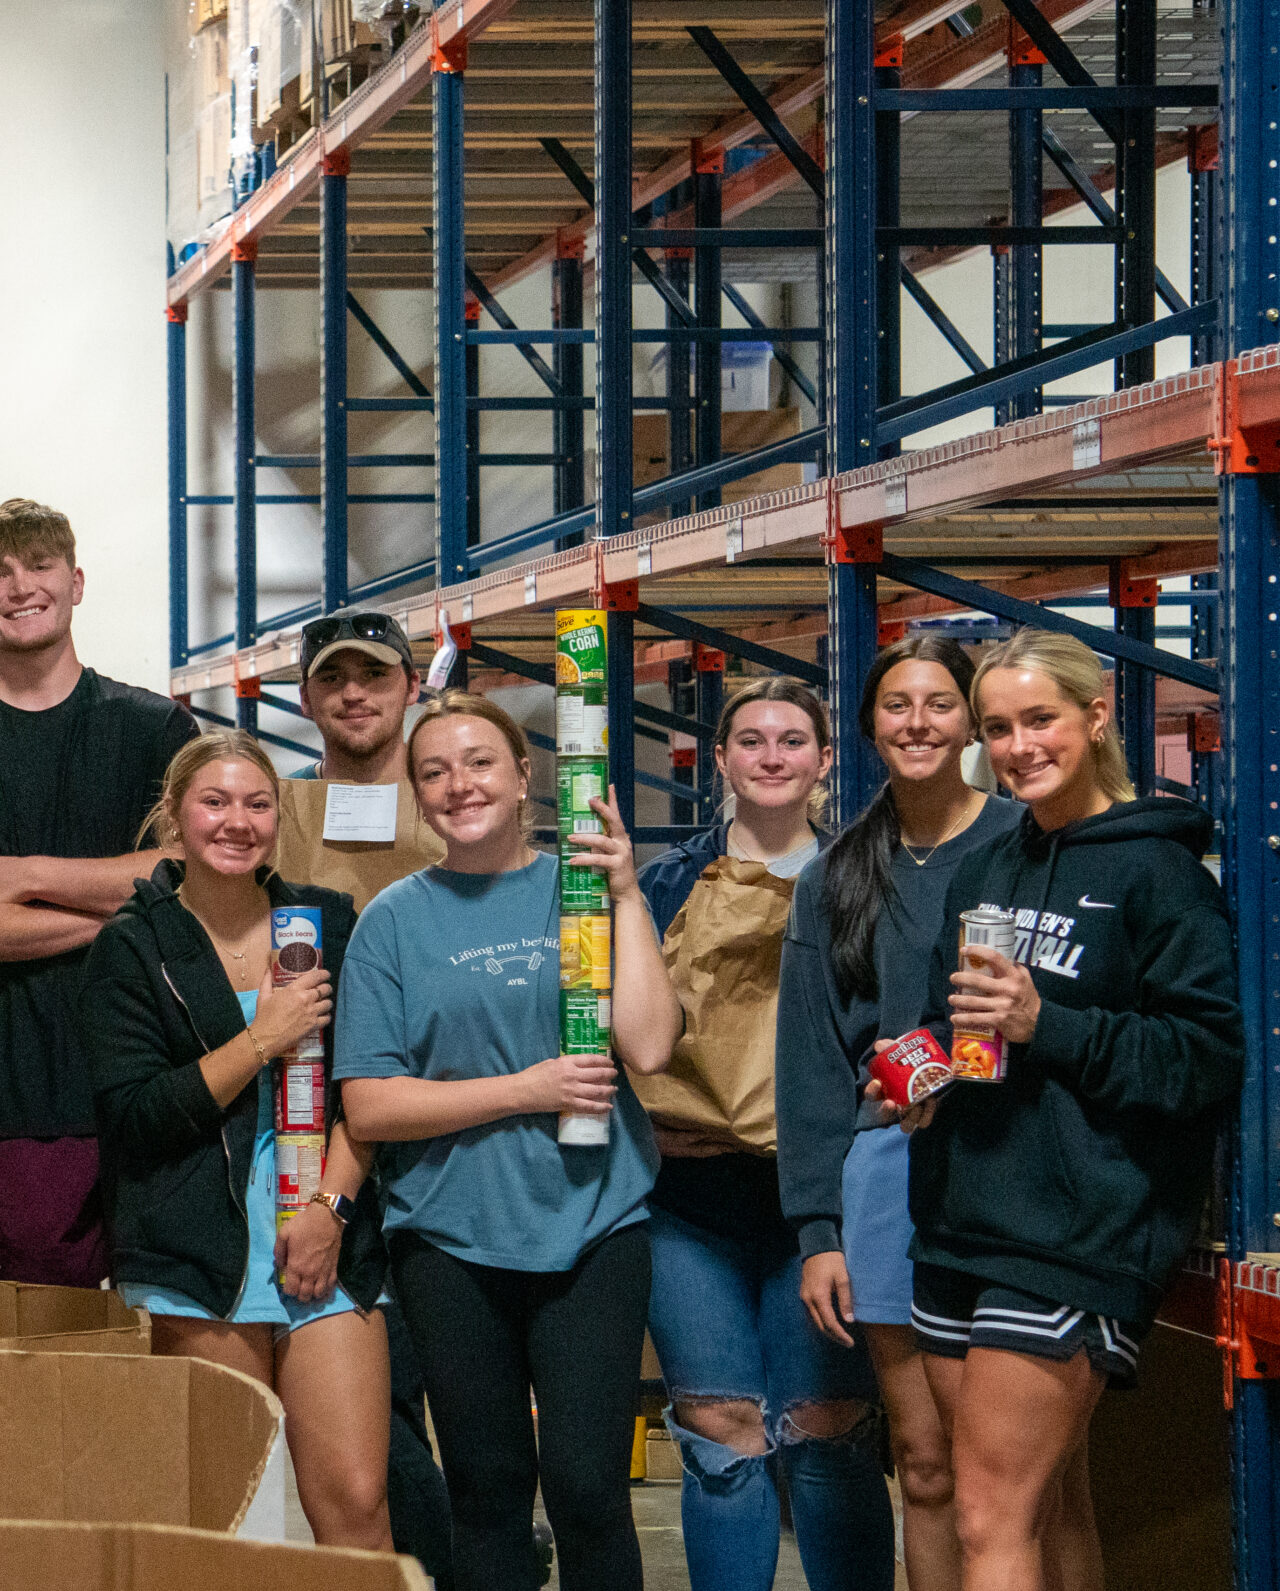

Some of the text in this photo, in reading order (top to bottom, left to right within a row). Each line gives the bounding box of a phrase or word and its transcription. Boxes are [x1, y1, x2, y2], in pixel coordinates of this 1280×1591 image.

[569, 634, 599, 653] CORN
[449, 946, 495, 966] Lifting
[497, 942, 518, 952] my
[507, 978, 528, 986] AYBL
[900, 1046, 925, 1066] BEEF
[910, 1052, 932, 1068] STEW
